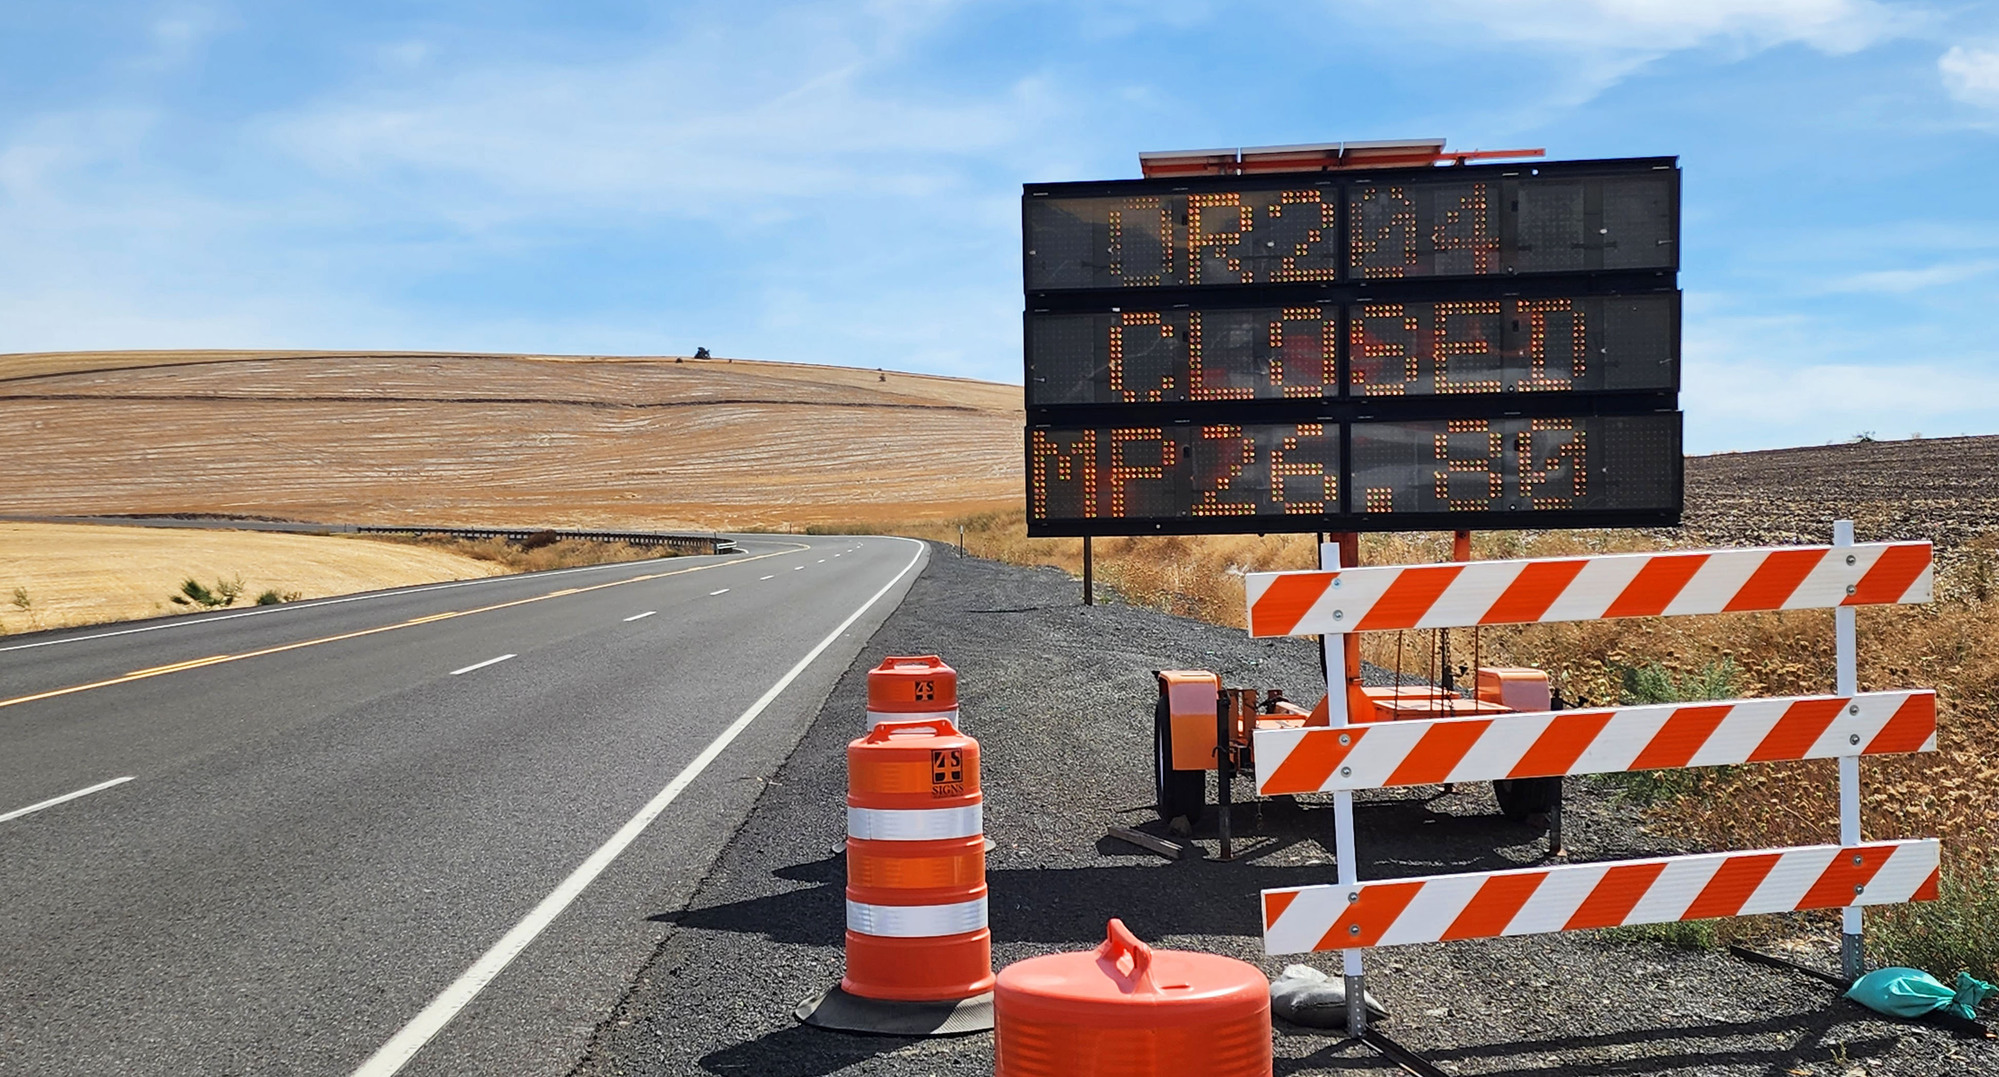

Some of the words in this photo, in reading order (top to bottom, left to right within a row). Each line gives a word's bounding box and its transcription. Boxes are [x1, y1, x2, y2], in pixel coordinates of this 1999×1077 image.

[1109, 182, 1501, 287] OR204
[1109, 299, 1588, 403] CLOSED
[1031, 417, 1588, 520] MP26.80
[932, 784, 964, 795] SIGNS
